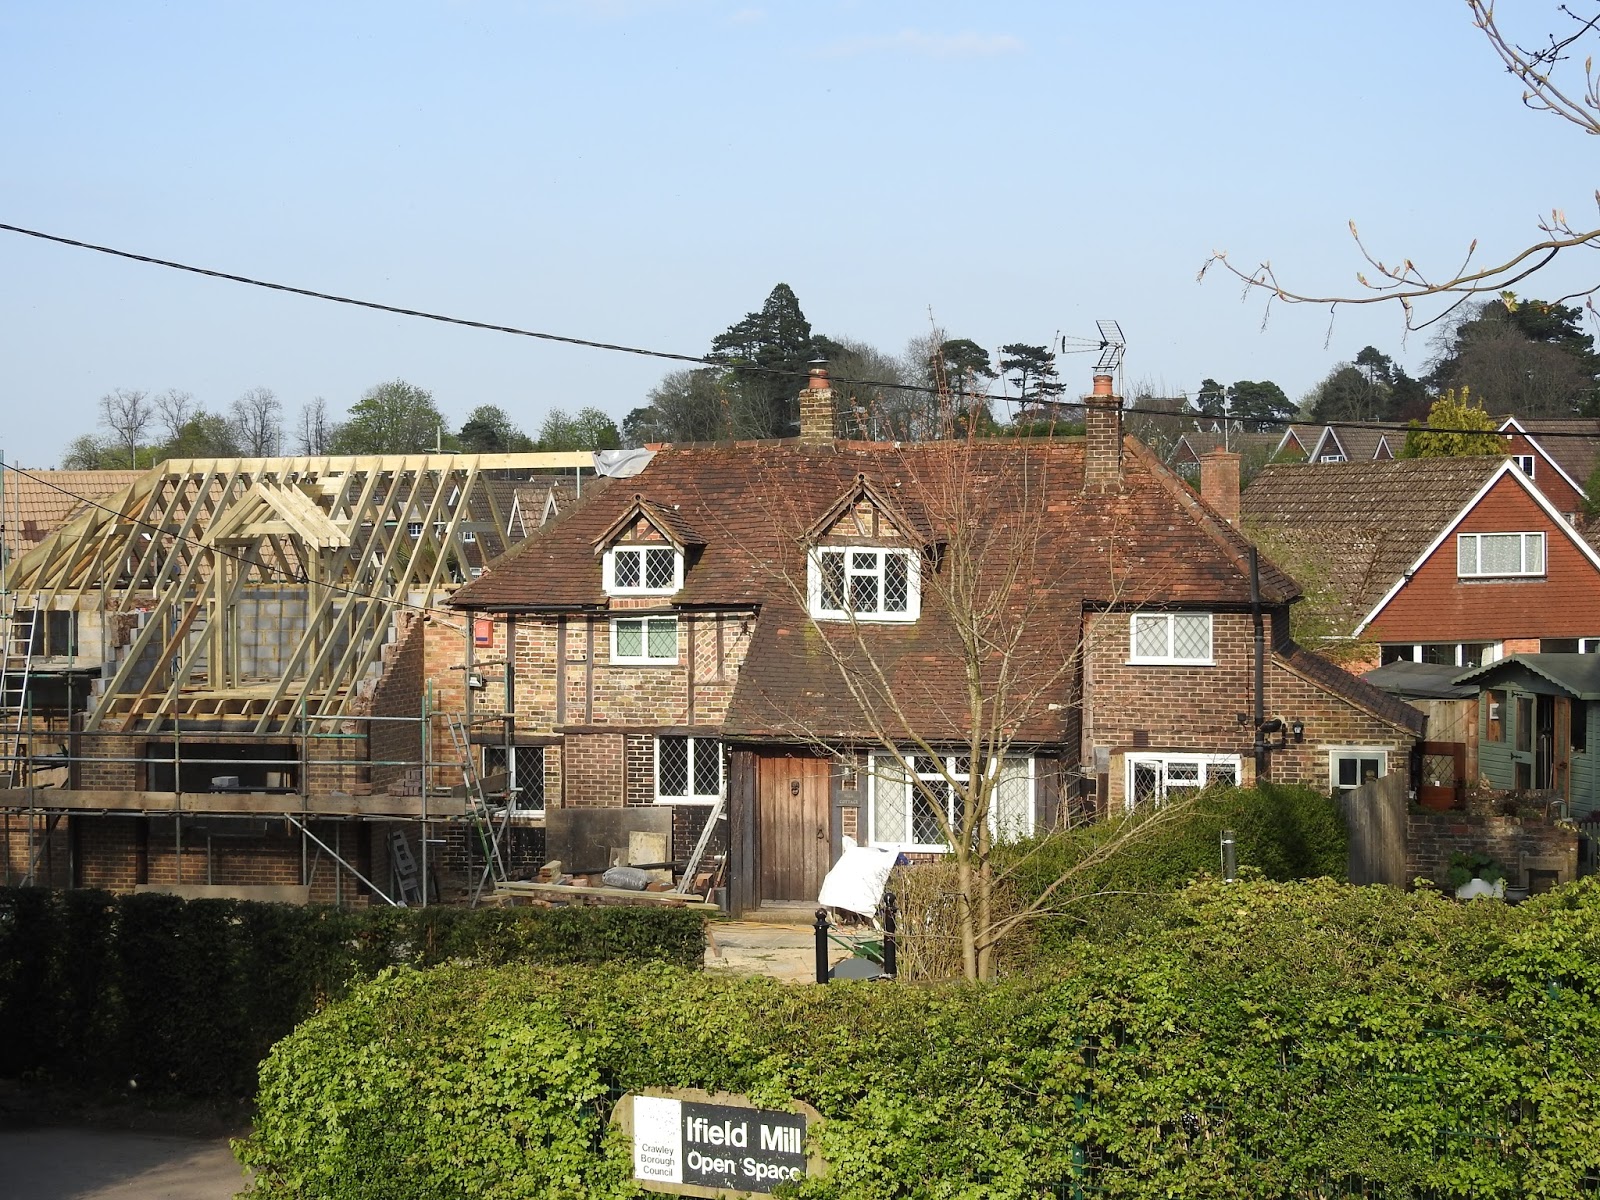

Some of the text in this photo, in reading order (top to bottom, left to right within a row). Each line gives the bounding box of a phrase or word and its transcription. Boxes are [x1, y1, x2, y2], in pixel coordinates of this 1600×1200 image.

[686, 1116, 801, 1154] Ifield Mill
[641, 1143, 674, 1156] Crawley
[640, 1153, 675, 1167] Borough
[687, 1151, 736, 1175] Open
[643, 1165, 673, 1177] Council
